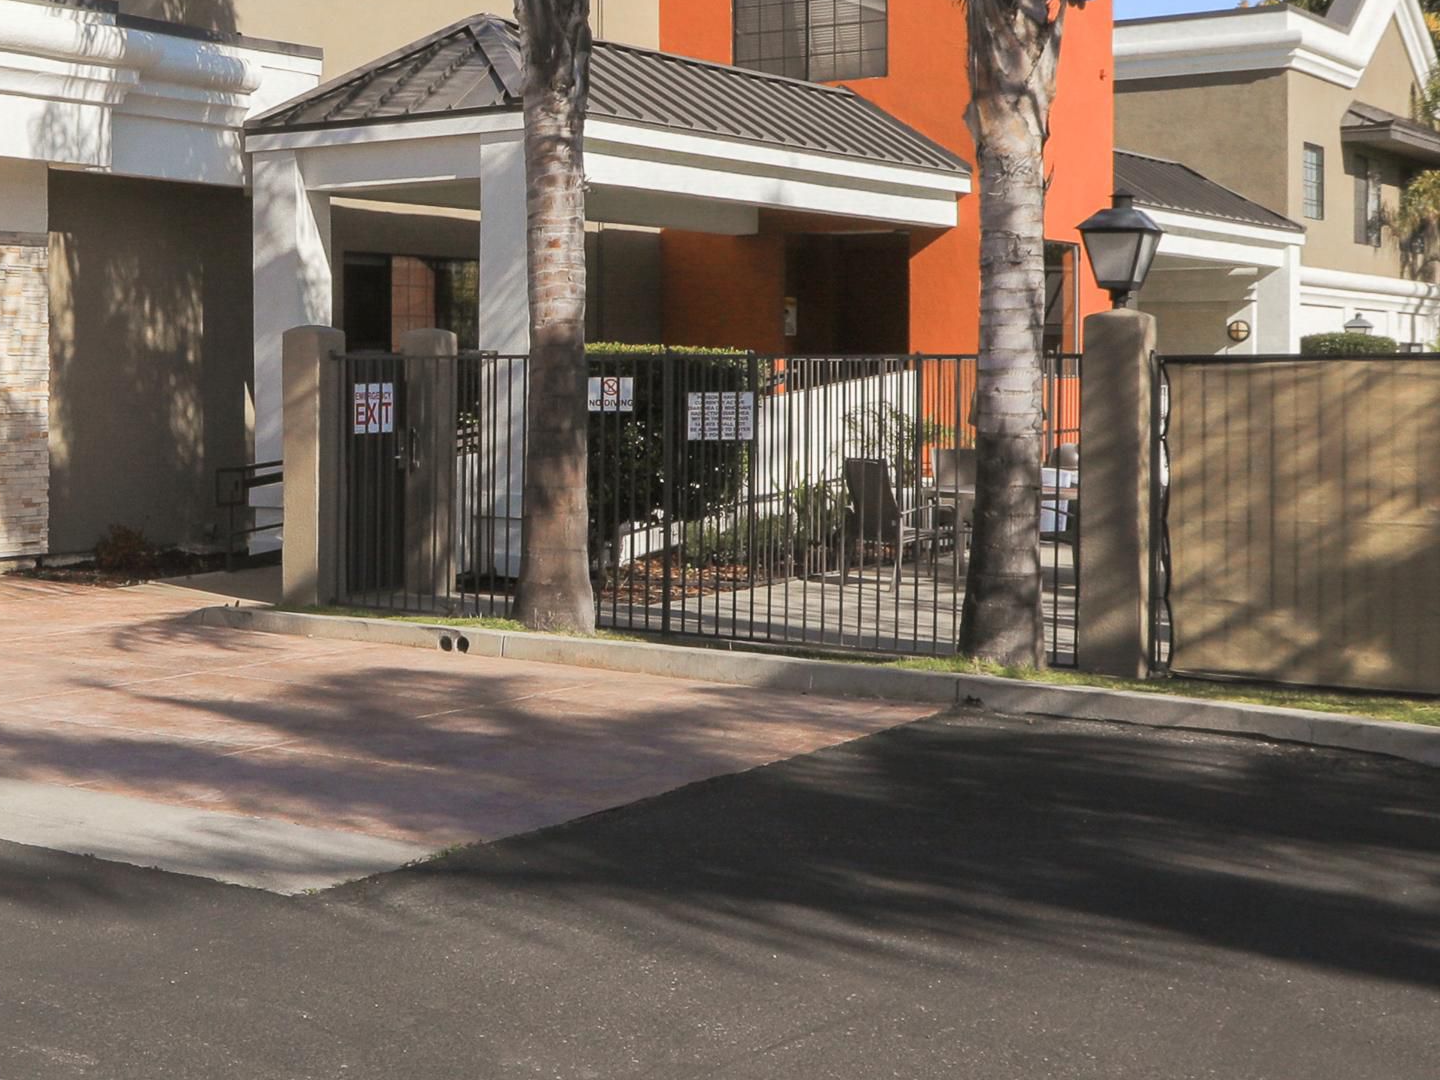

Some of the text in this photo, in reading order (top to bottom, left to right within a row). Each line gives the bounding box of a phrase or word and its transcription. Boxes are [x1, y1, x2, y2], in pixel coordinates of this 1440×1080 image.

[355, 392, 392, 400] EMRGECY
[589, 399, 635, 408] NO DIVNG
[355, 402, 392, 425] EXT
